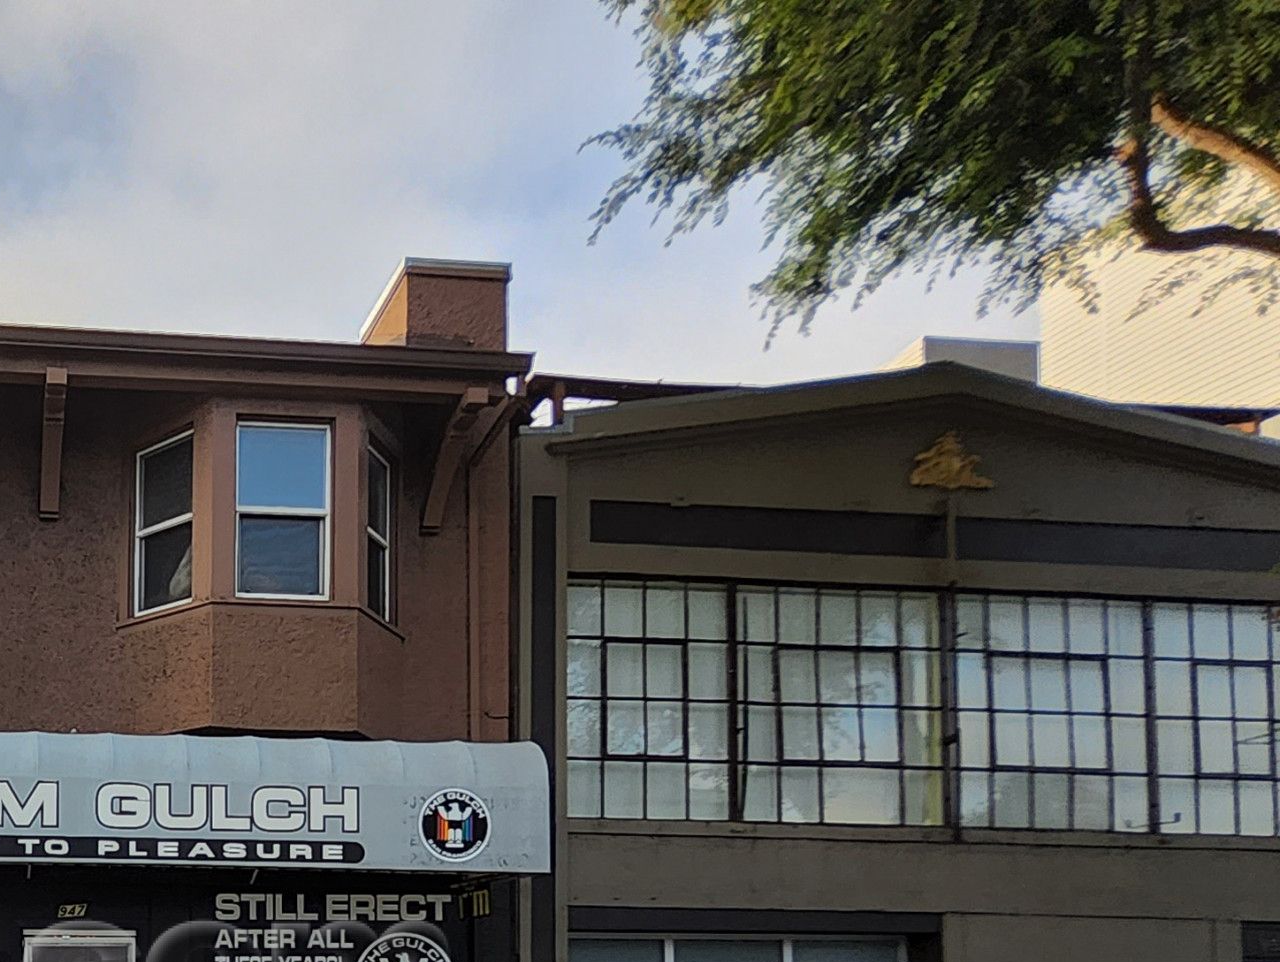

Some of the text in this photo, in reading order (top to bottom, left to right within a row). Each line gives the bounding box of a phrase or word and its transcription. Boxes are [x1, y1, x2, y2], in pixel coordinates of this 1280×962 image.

[95, 782, 360, 833] GULCH
[424, 791, 487, 819] THE GULCH
[17, 838, 70, 855] TO
[98, 839, 345, 860] PLEASURE
[59, 905, 85, 917] 947
[215, 893, 452, 921] STILL ERECT
[214, 929, 354, 949] AFTER ALL
